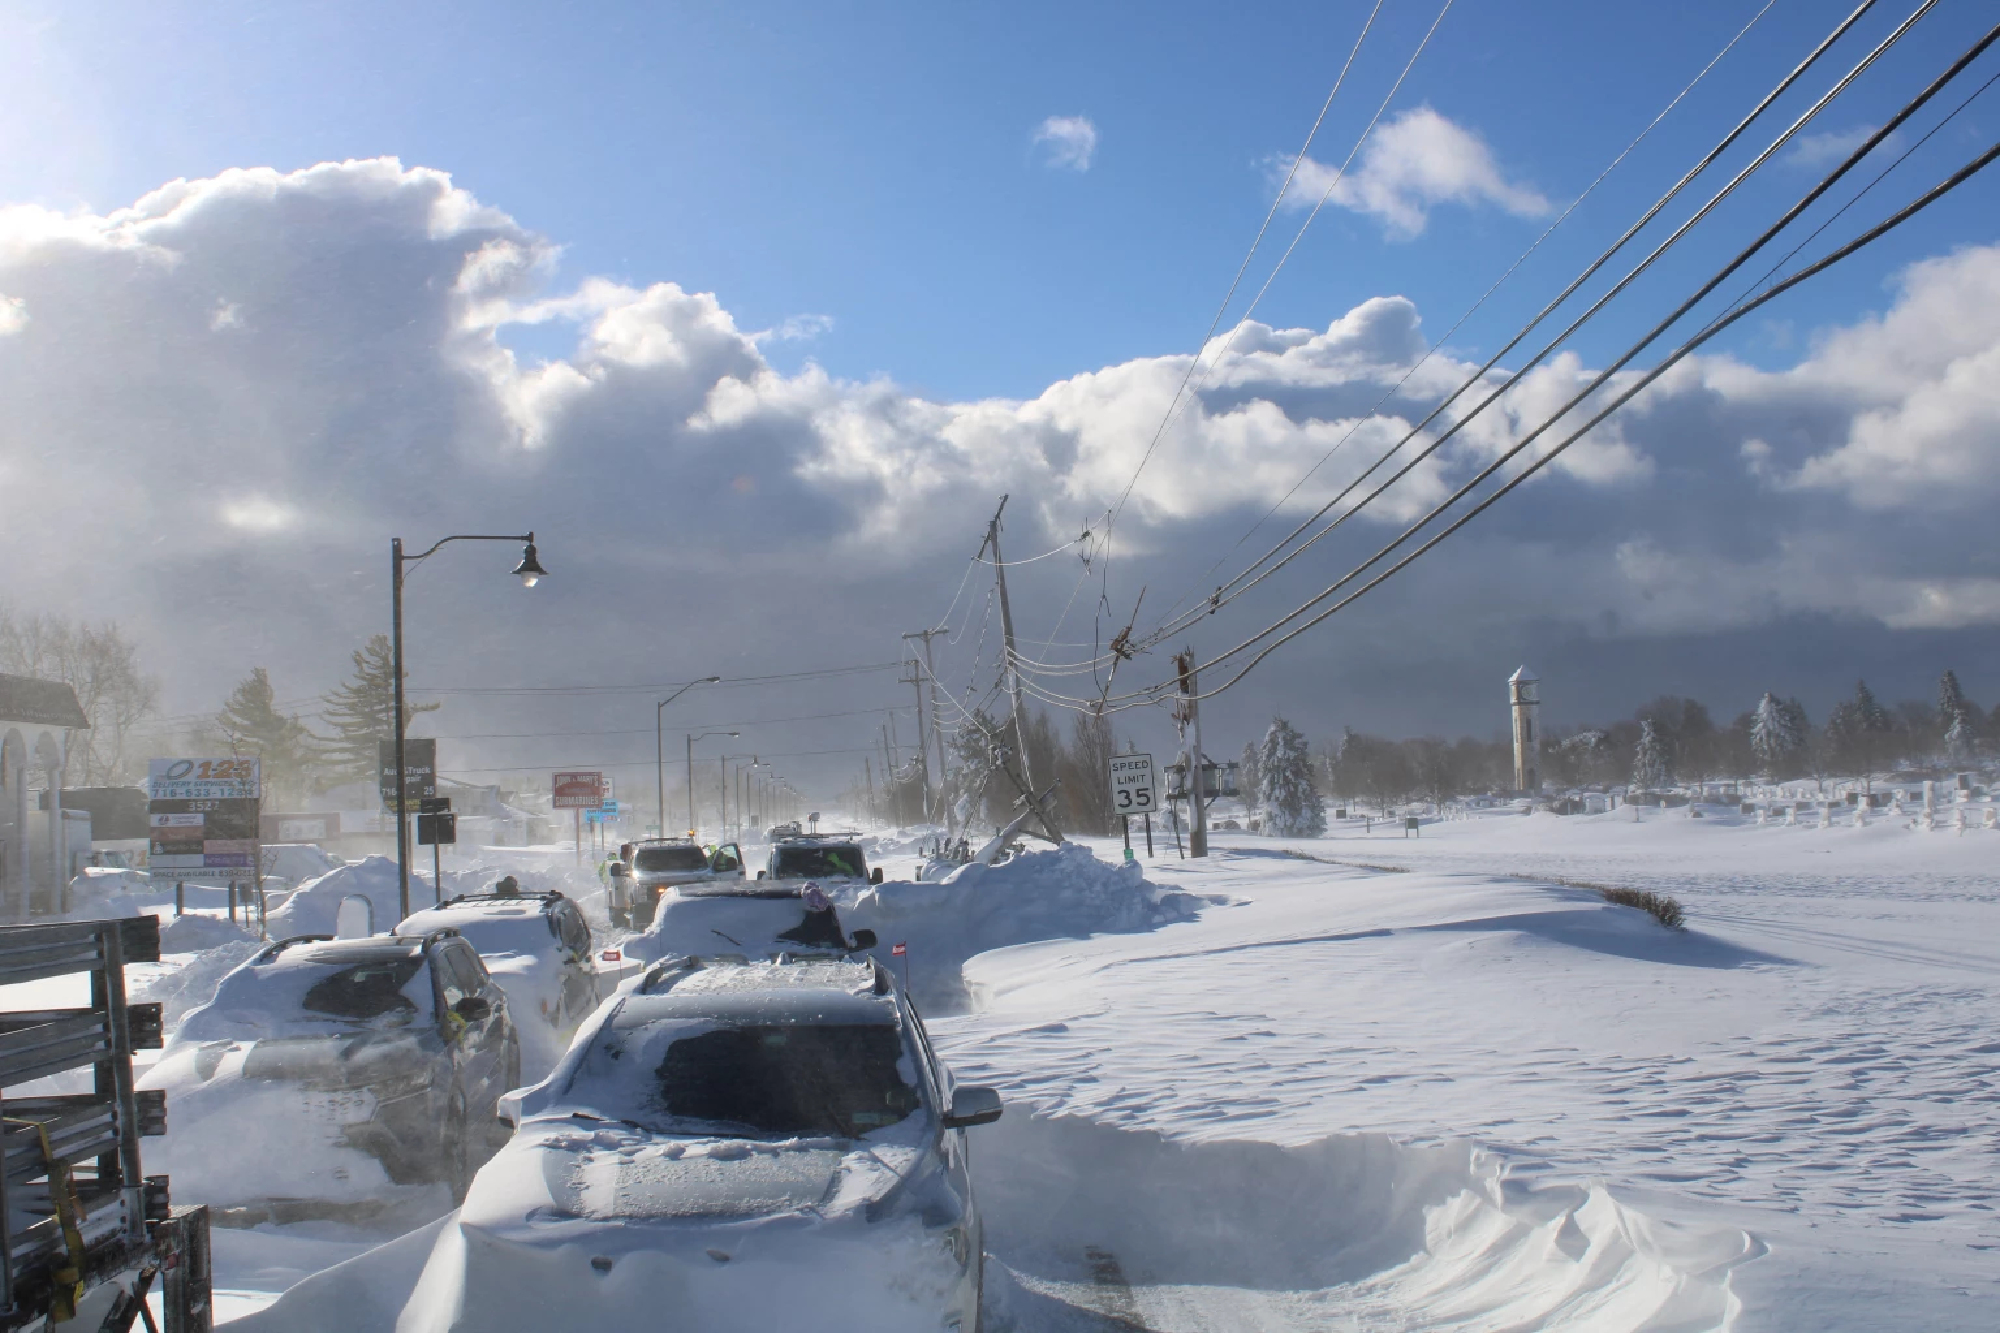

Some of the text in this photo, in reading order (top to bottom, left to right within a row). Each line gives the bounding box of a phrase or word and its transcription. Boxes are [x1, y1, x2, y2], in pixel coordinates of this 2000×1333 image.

[1112, 760, 1149, 771] SPEED
[1117, 774, 1146, 785] LIMIT
[555, 796, 599, 806] SUBMARINES
[1117, 788, 1150, 808] 35
